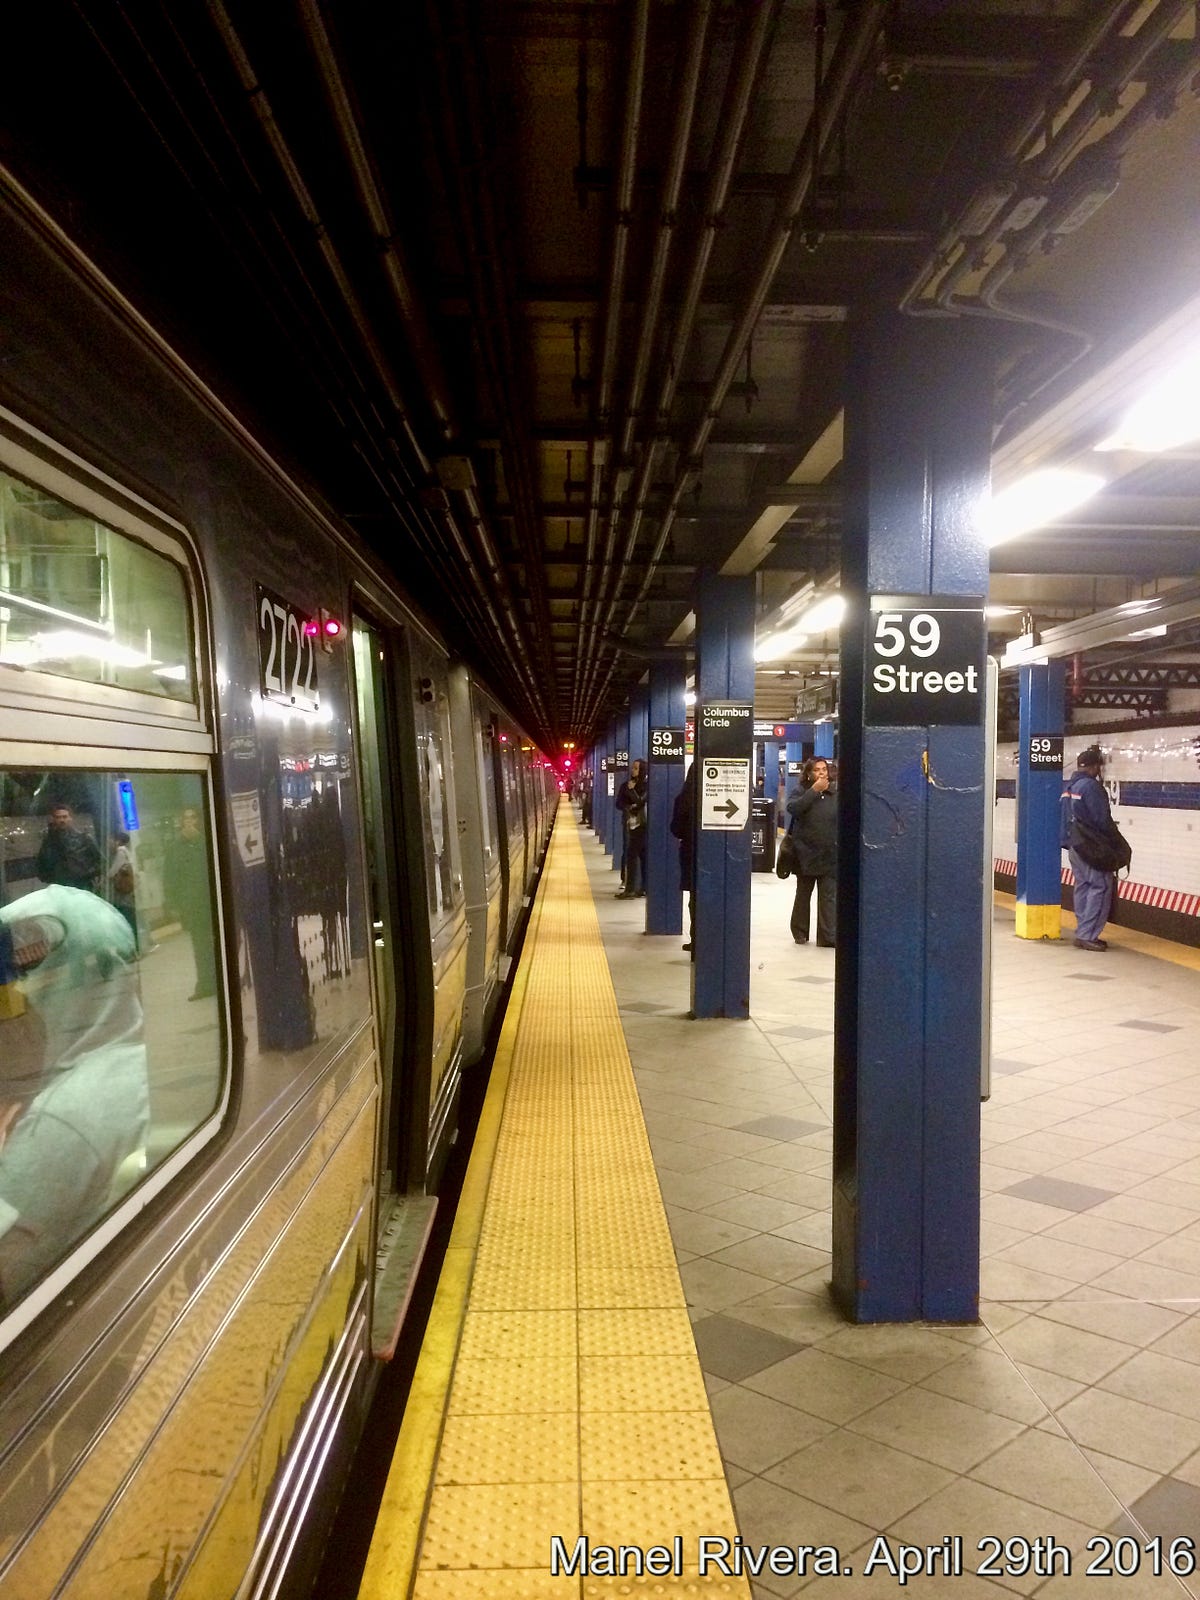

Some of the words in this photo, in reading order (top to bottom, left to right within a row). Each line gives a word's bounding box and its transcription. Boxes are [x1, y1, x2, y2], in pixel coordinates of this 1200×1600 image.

[873, 613, 941, 658] 59
[260, 597, 320, 699] 2722
[873, 664, 978, 693] Street
[703, 708, 750, 717] Columbus
[703, 718, 730, 727] Circle
[652, 732, 673, 745] 59
[652, 746, 683, 756] Street
[1030, 739, 1051, 753] 59
[616, 752, 629, 761] 59
[1030, 753, 1062, 763] Street
